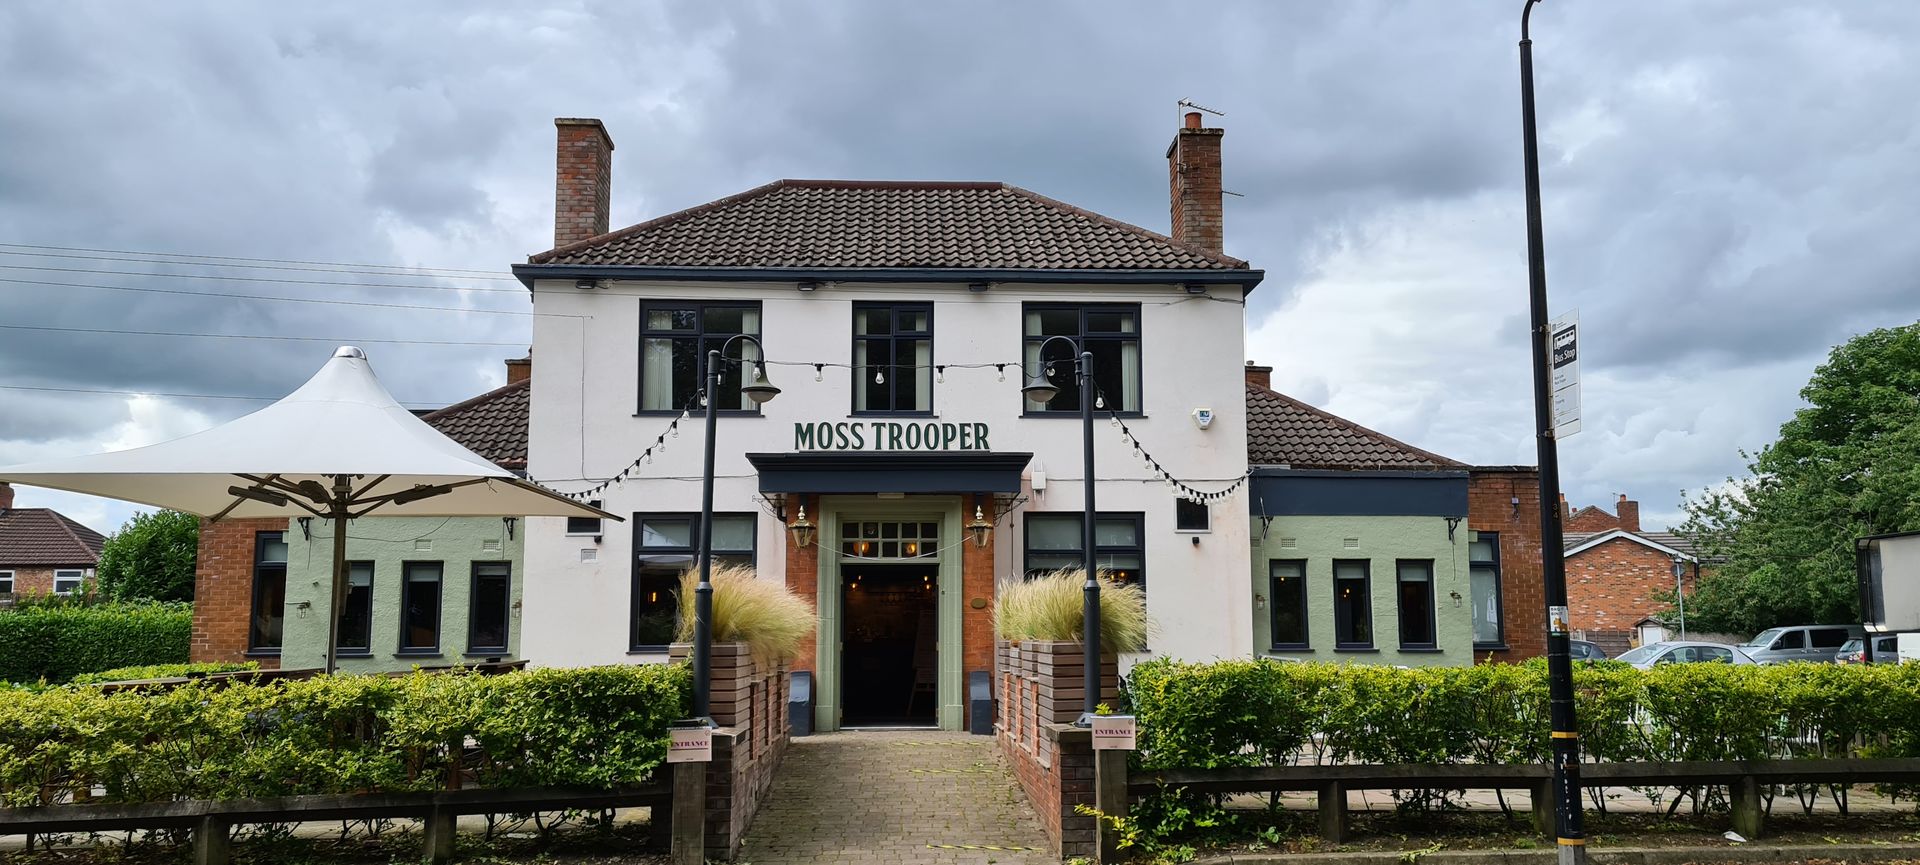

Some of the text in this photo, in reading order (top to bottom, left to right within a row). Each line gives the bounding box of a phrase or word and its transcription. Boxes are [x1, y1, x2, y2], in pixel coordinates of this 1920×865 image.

[1555, 349, 1575, 364] Bus Stop
[794, 422, 990, 450] MOSS TROOPER
